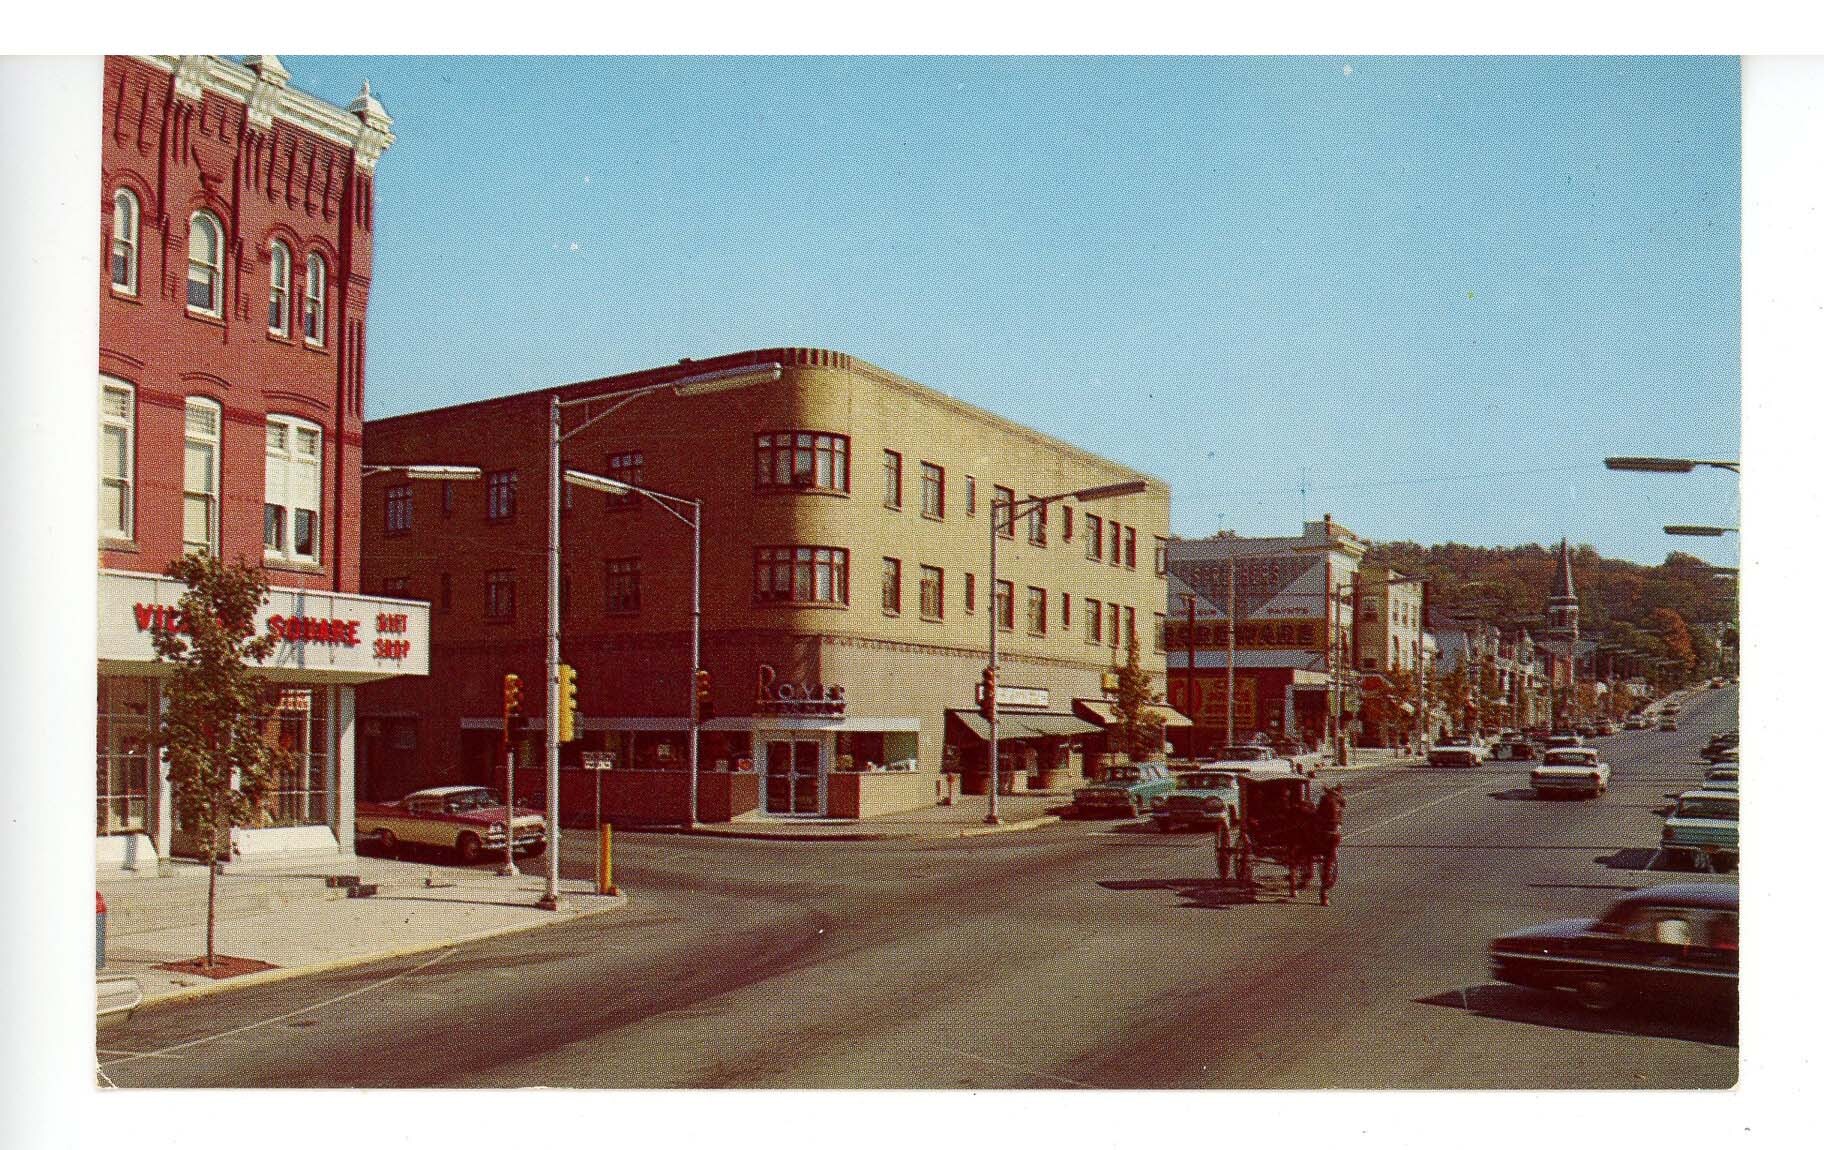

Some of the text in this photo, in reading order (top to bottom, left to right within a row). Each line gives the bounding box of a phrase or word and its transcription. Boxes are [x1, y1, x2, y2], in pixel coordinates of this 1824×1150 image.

[268, 614, 362, 647] SQUARE
[376, 612, 409, 634] GIFT
[374, 638, 411, 660] SHOP
